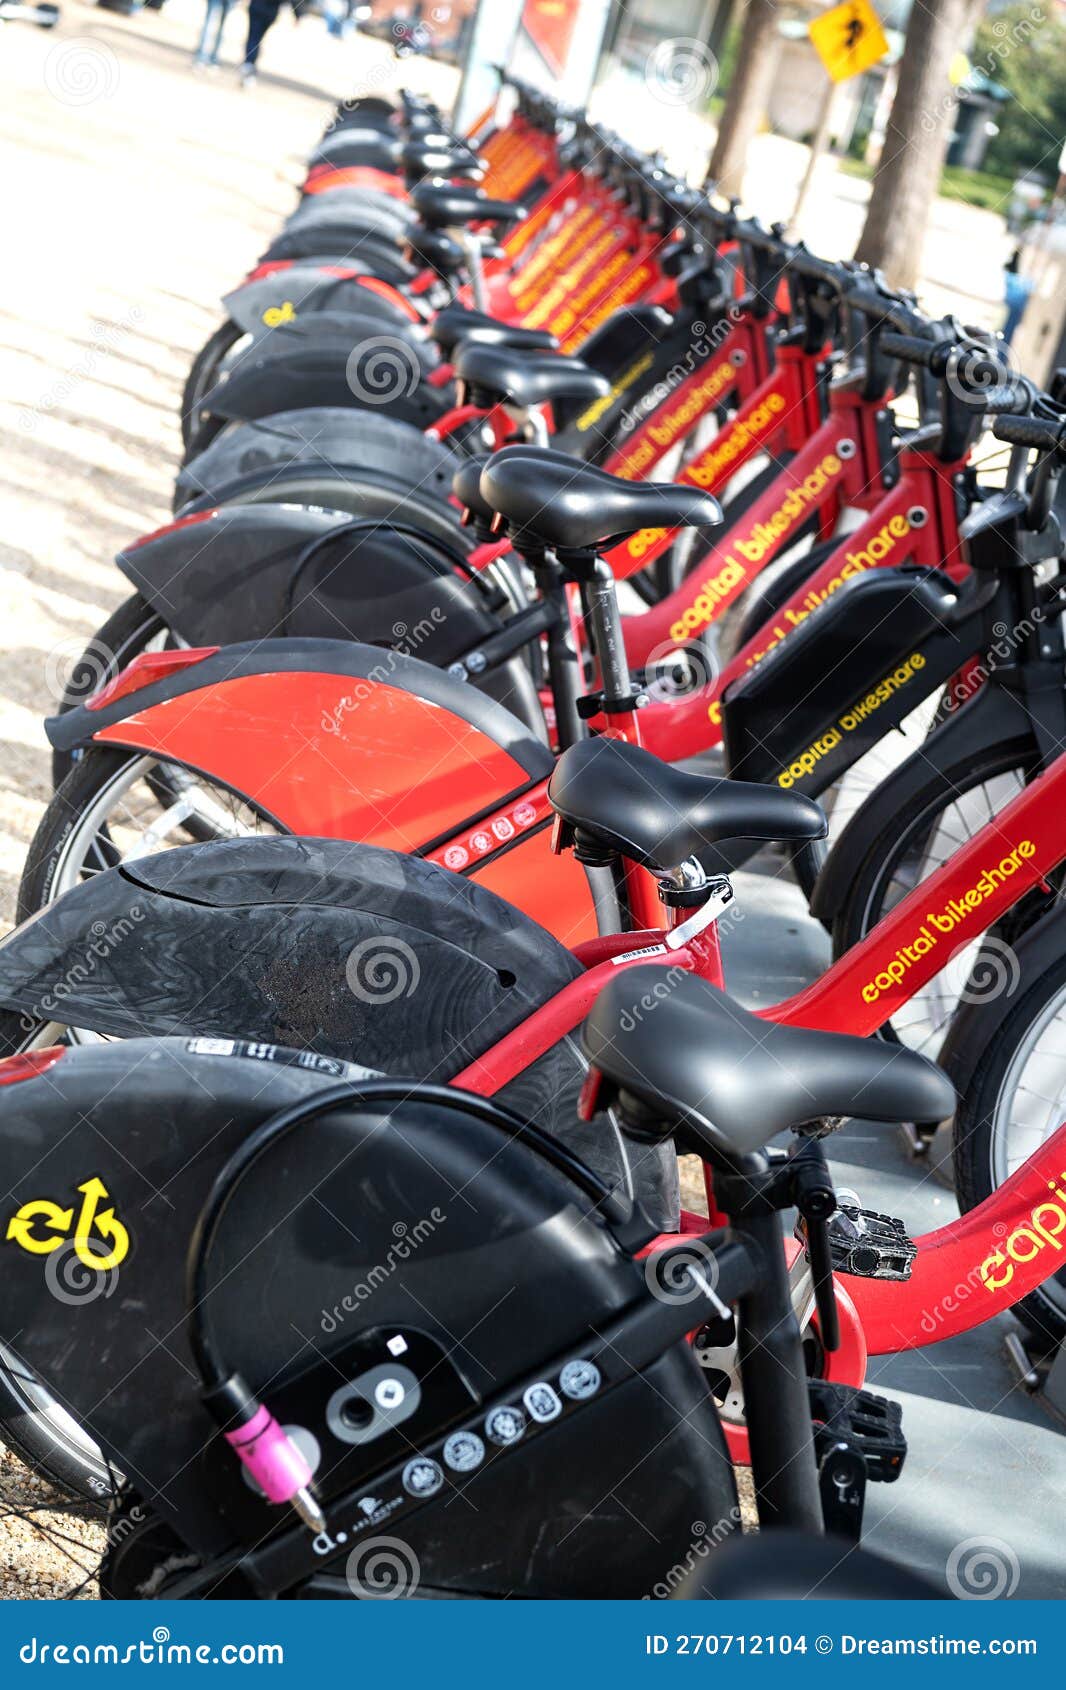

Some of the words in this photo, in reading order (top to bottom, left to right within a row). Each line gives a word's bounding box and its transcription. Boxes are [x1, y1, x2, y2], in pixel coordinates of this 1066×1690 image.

[670, 556, 746, 642] capital
[733, 453, 842, 562] bikeshare
[777, 727, 842, 790] capital
[839, 652, 927, 733] bikeshare
[861, 926, 938, 1004] capital
[926, 840, 1036, 934] bikeshare
[980, 1171, 1066, 1293] capi
